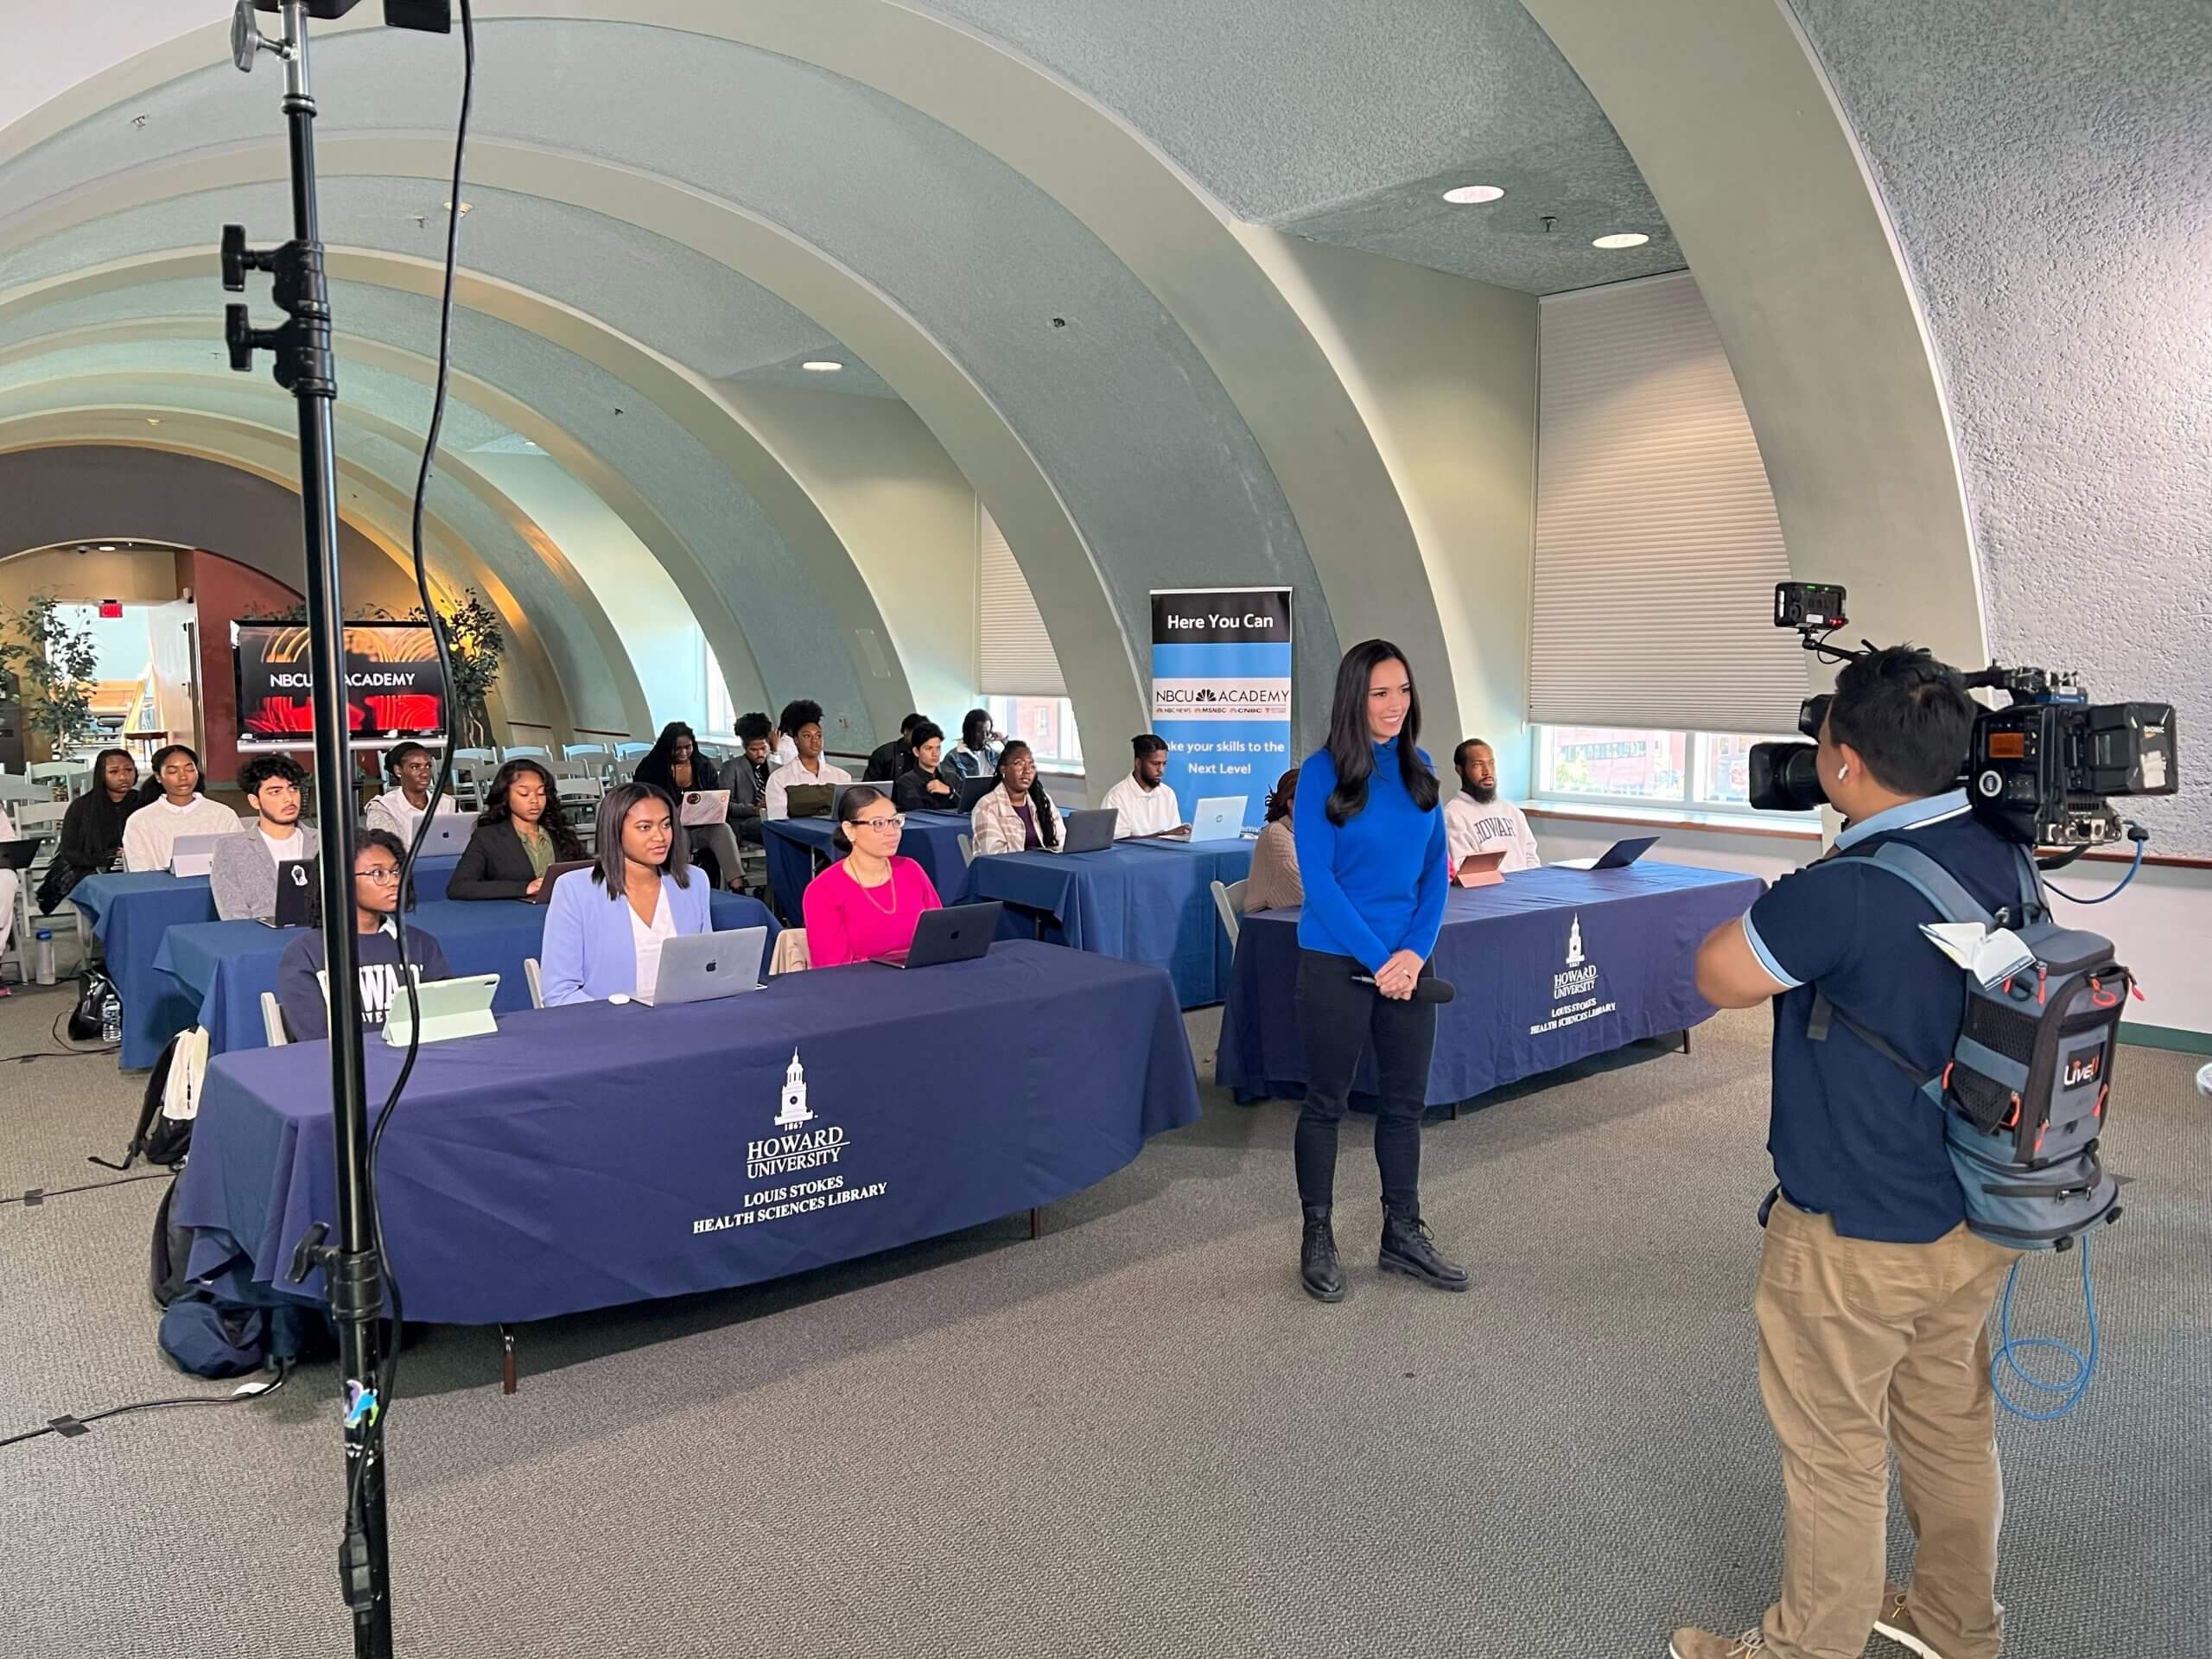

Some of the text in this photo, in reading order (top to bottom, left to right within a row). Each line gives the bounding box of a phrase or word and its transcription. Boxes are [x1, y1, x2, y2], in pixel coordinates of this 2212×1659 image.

[1167, 613, 1274, 629] Here You Can
[270, 673, 313, 687] NBCU
[1156, 690, 1289, 702] NBCU ACADEMY
[1167, 741, 1285, 753] ke your skills to the
[1188, 763, 1251, 774] Next Level
[1473, 817, 1516, 843] HOWAR
[1554, 965, 1597, 987] HOWARD
[1554, 979, 1595, 1000] UNIVERSITY
[1529, 1002, 1617, 1035] HEALTH SCIENCES LIBRARY
[747, 1126, 844, 1160] HOWARD
[747, 1147, 842, 1179] UNIVERSITY
[744, 1175, 844, 1207] LOUIS STOKES
[693, 1182, 888, 1234] HEALTH SCIENCES LIBRARY
